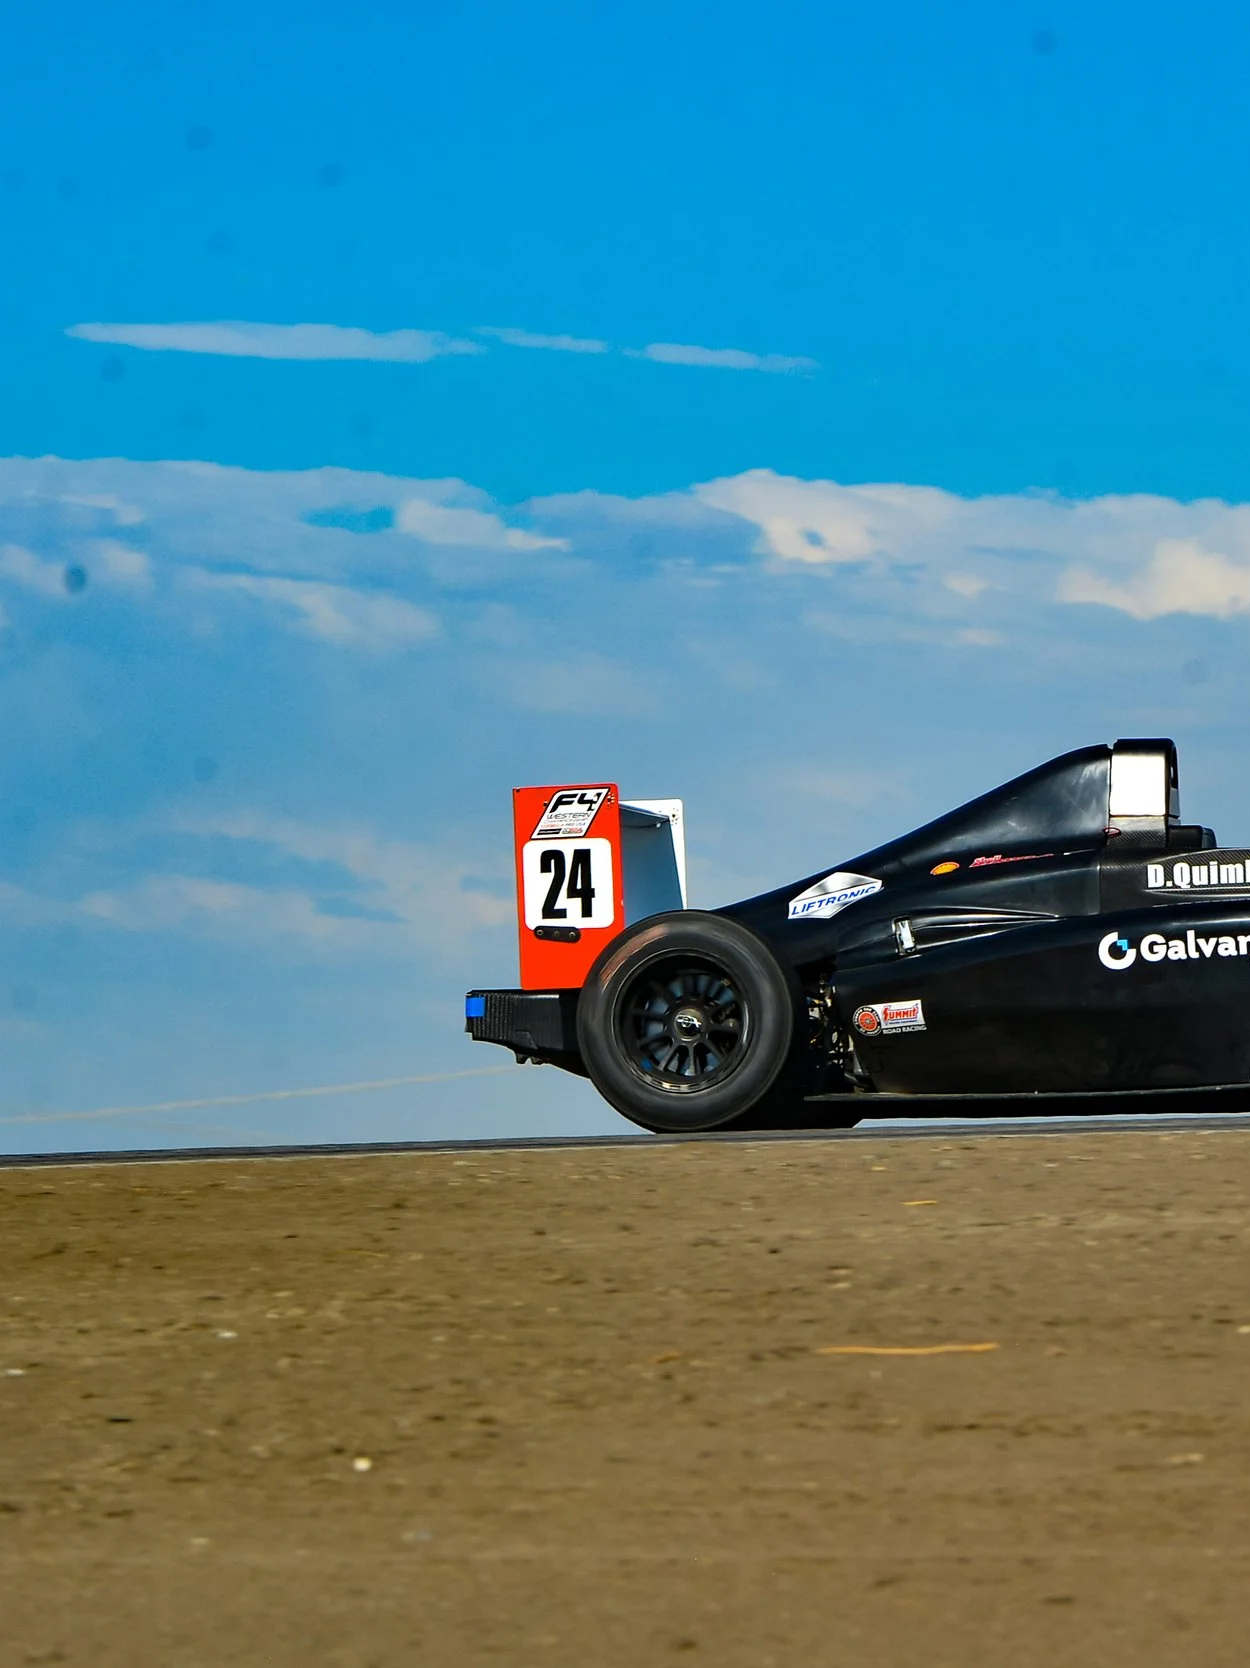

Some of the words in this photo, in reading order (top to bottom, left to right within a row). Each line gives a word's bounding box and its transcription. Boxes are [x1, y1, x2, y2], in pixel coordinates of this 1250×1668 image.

[549, 792, 603, 813] F4
[546, 812, 592, 820] WESTERN
[540, 849, 596, 919] 24
[791, 886, 877, 916] LIFTRONIC
[902, 1024, 927, 1032] RACING
